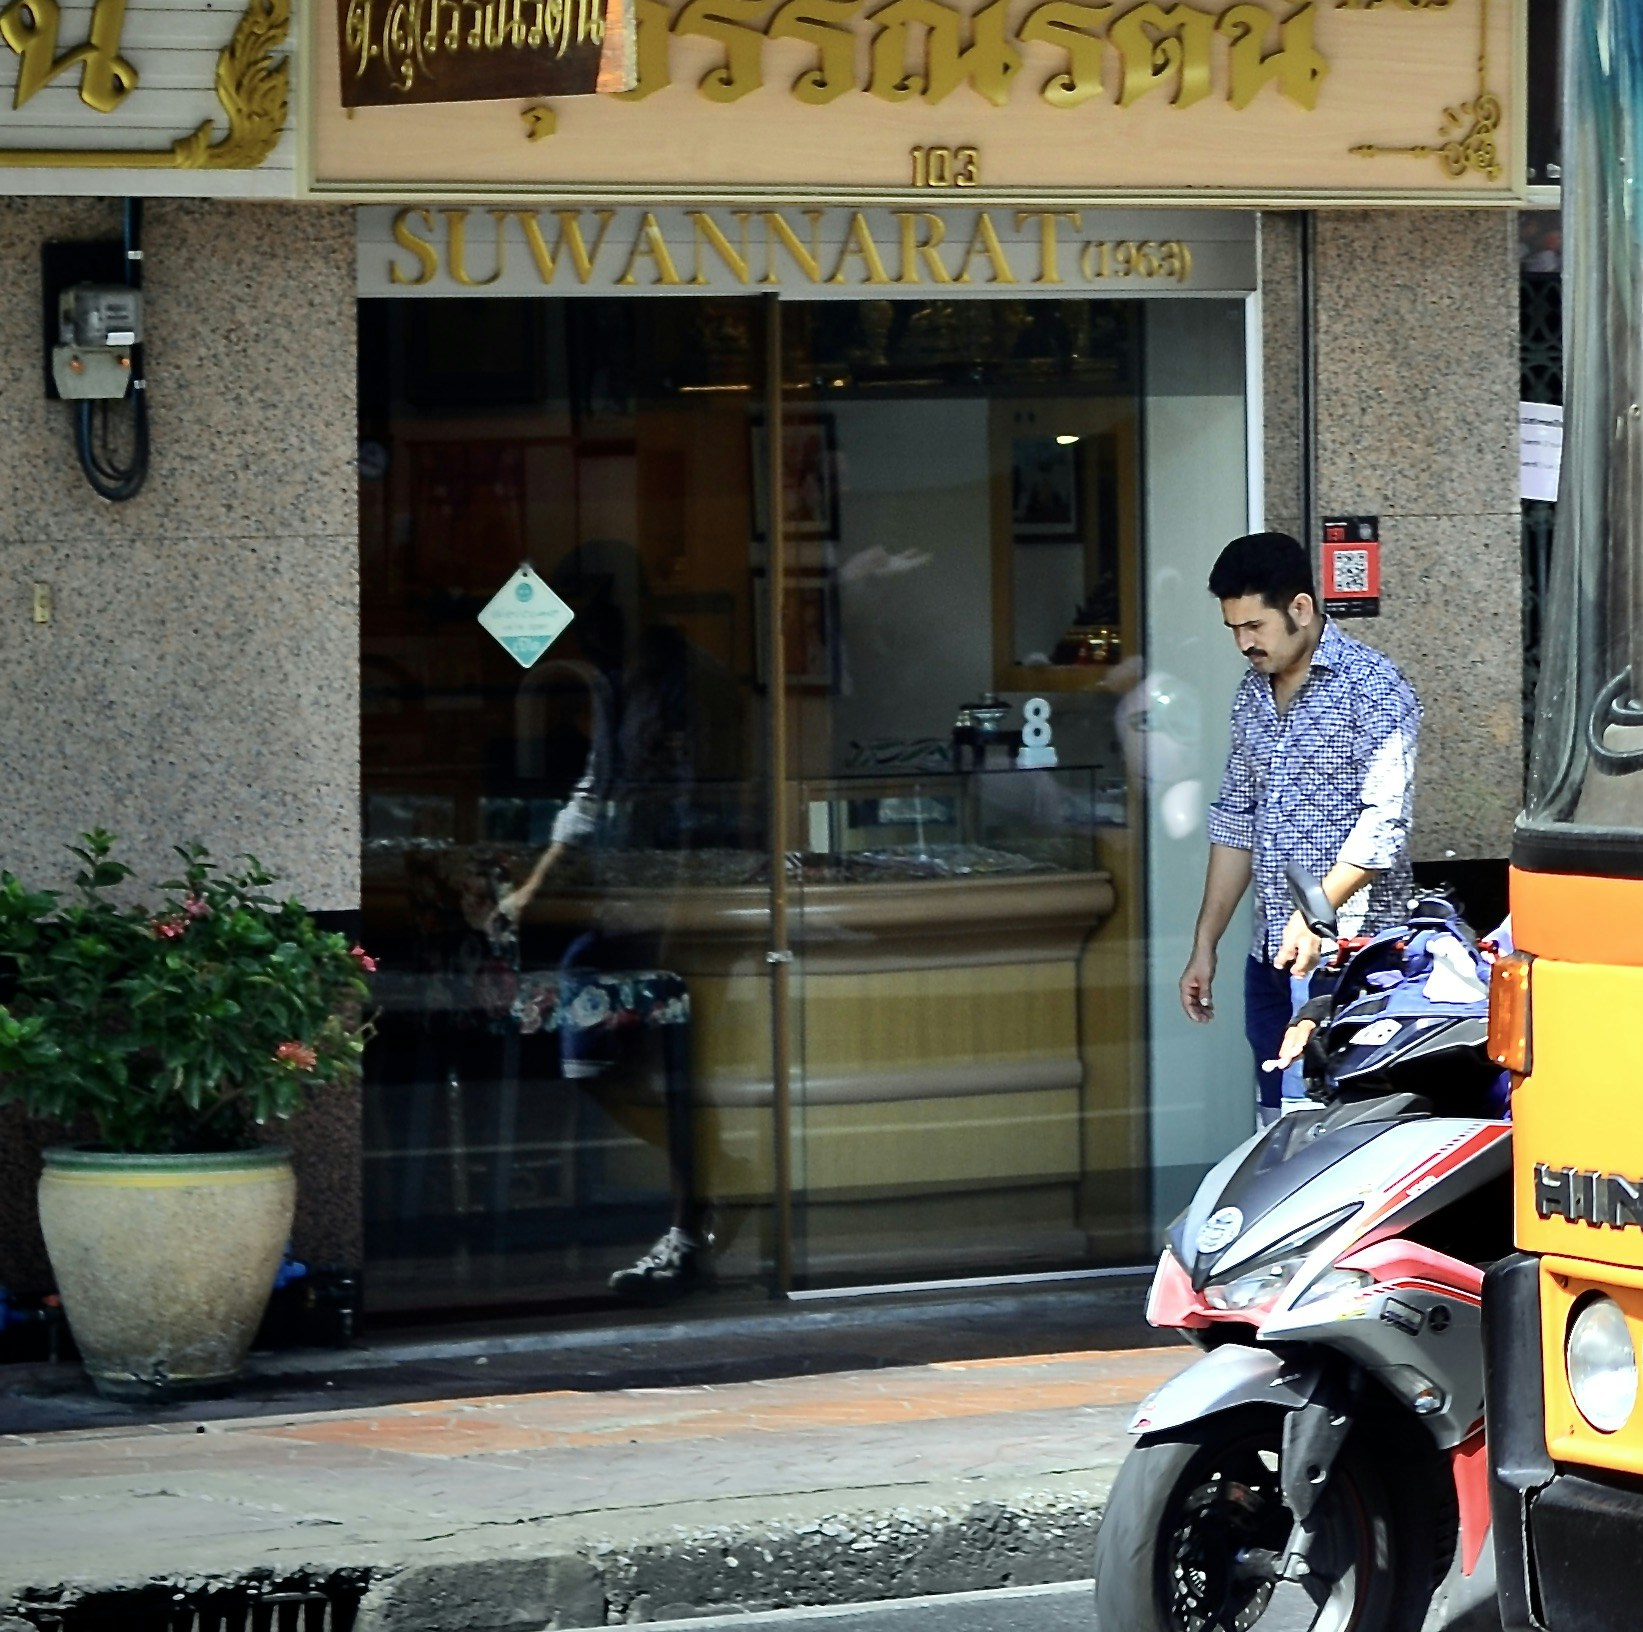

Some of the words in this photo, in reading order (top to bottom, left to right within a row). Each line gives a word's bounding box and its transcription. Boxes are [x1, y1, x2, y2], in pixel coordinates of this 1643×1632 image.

[910, 145, 982, 188] 103
[388, 206, 1083, 287] SUWANNARAT
[1080, 239, 1194, 284] (1963)
